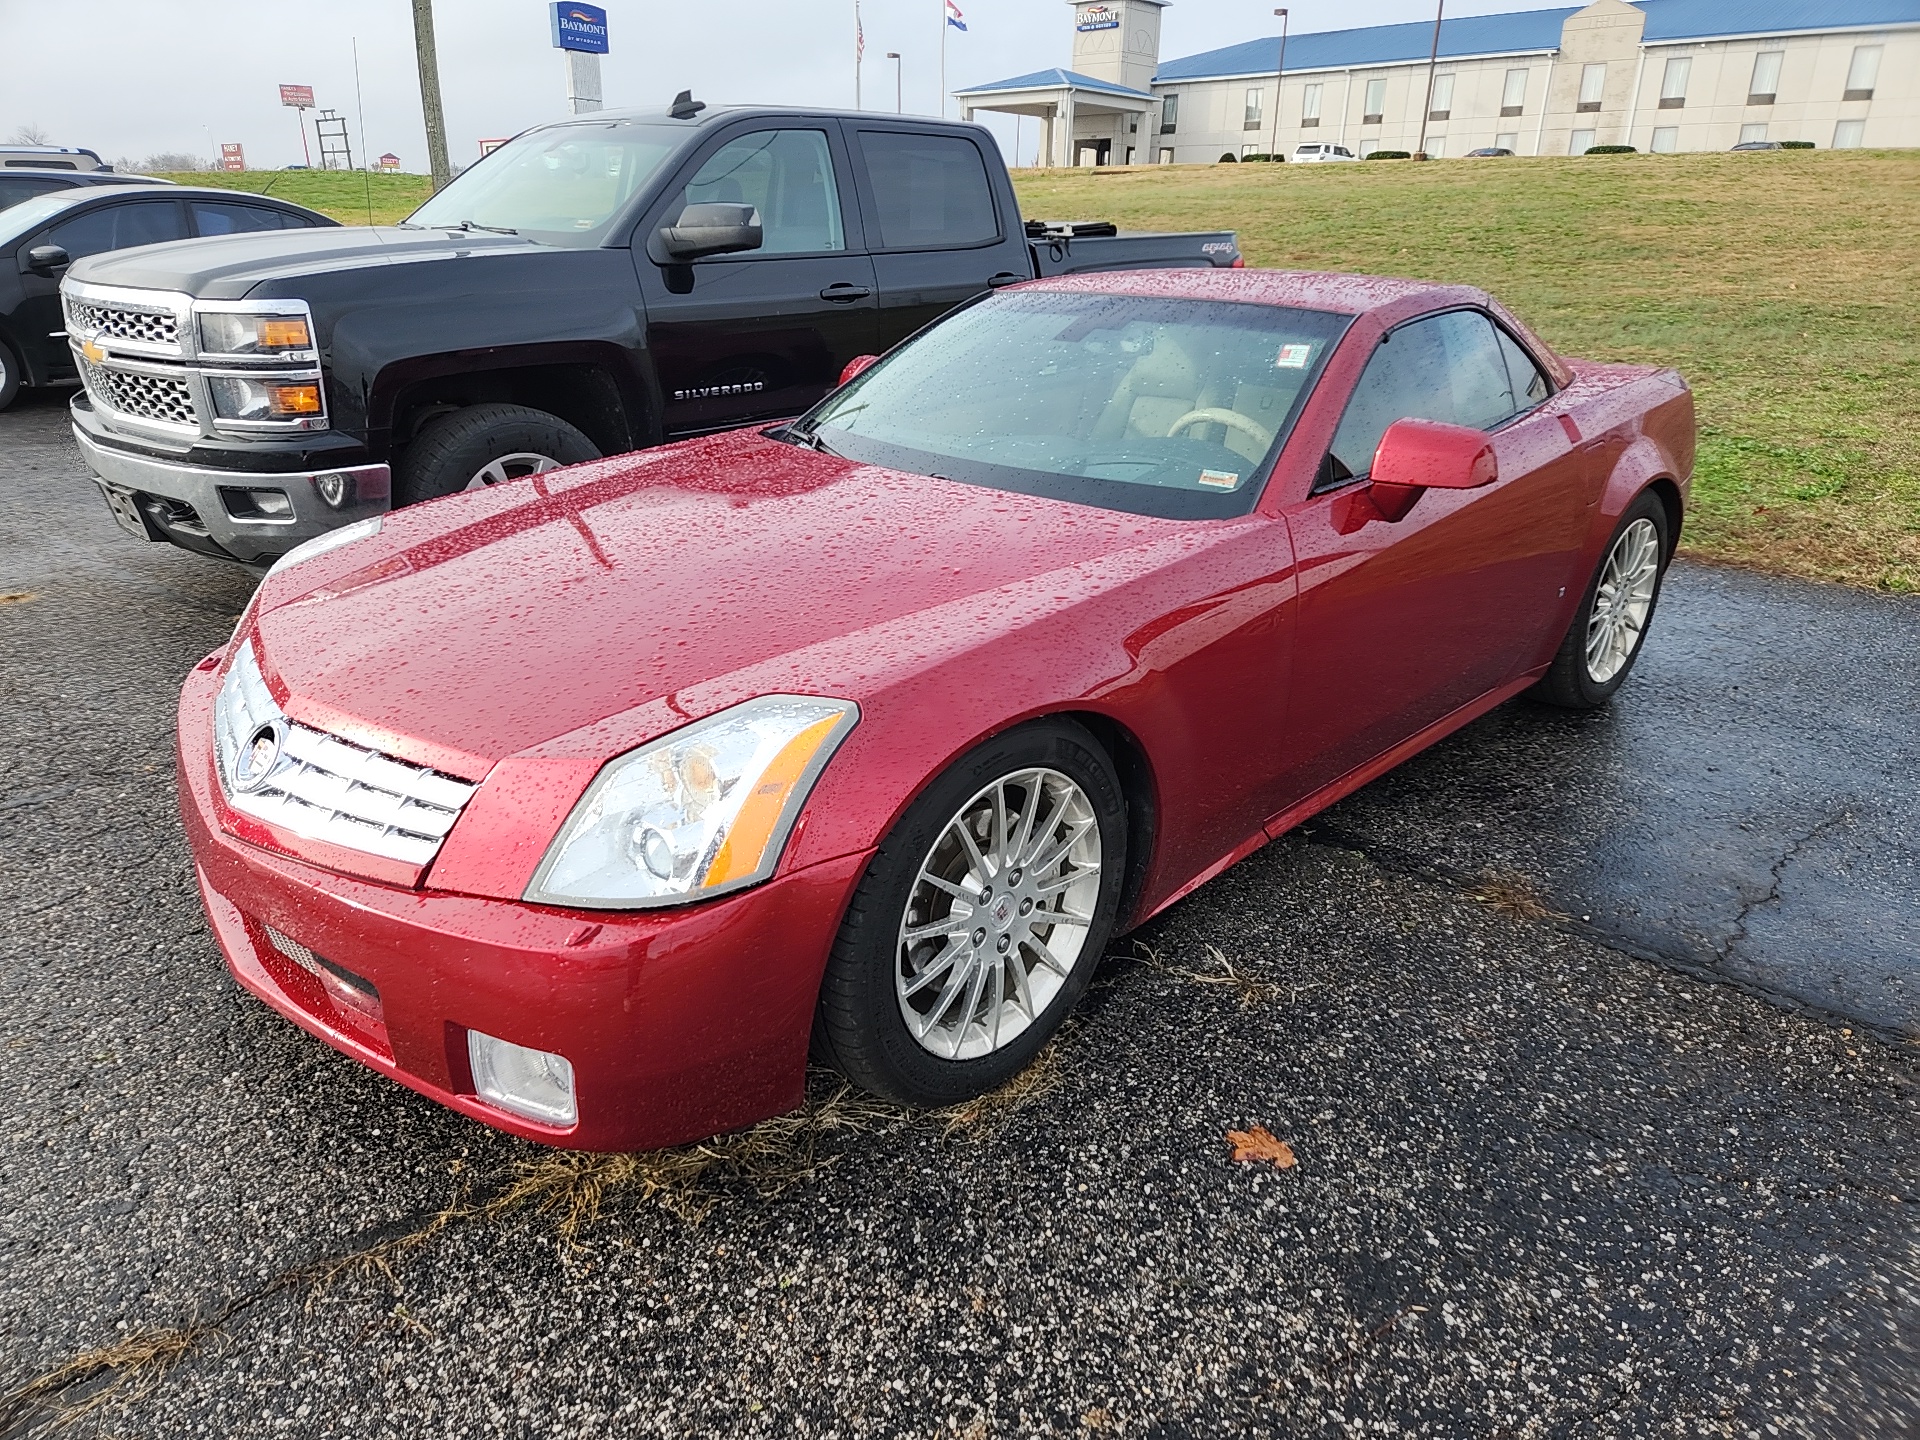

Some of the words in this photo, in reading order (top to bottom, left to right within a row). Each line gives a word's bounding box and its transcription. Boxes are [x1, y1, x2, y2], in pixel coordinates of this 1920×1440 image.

[560, 18, 606, 35] BAYMONT
[1077, 11, 1118, 24] BAYMONT
[674, 381, 763, 400] SILVERADO
[1074, 748, 1119, 814] MICHELIN
